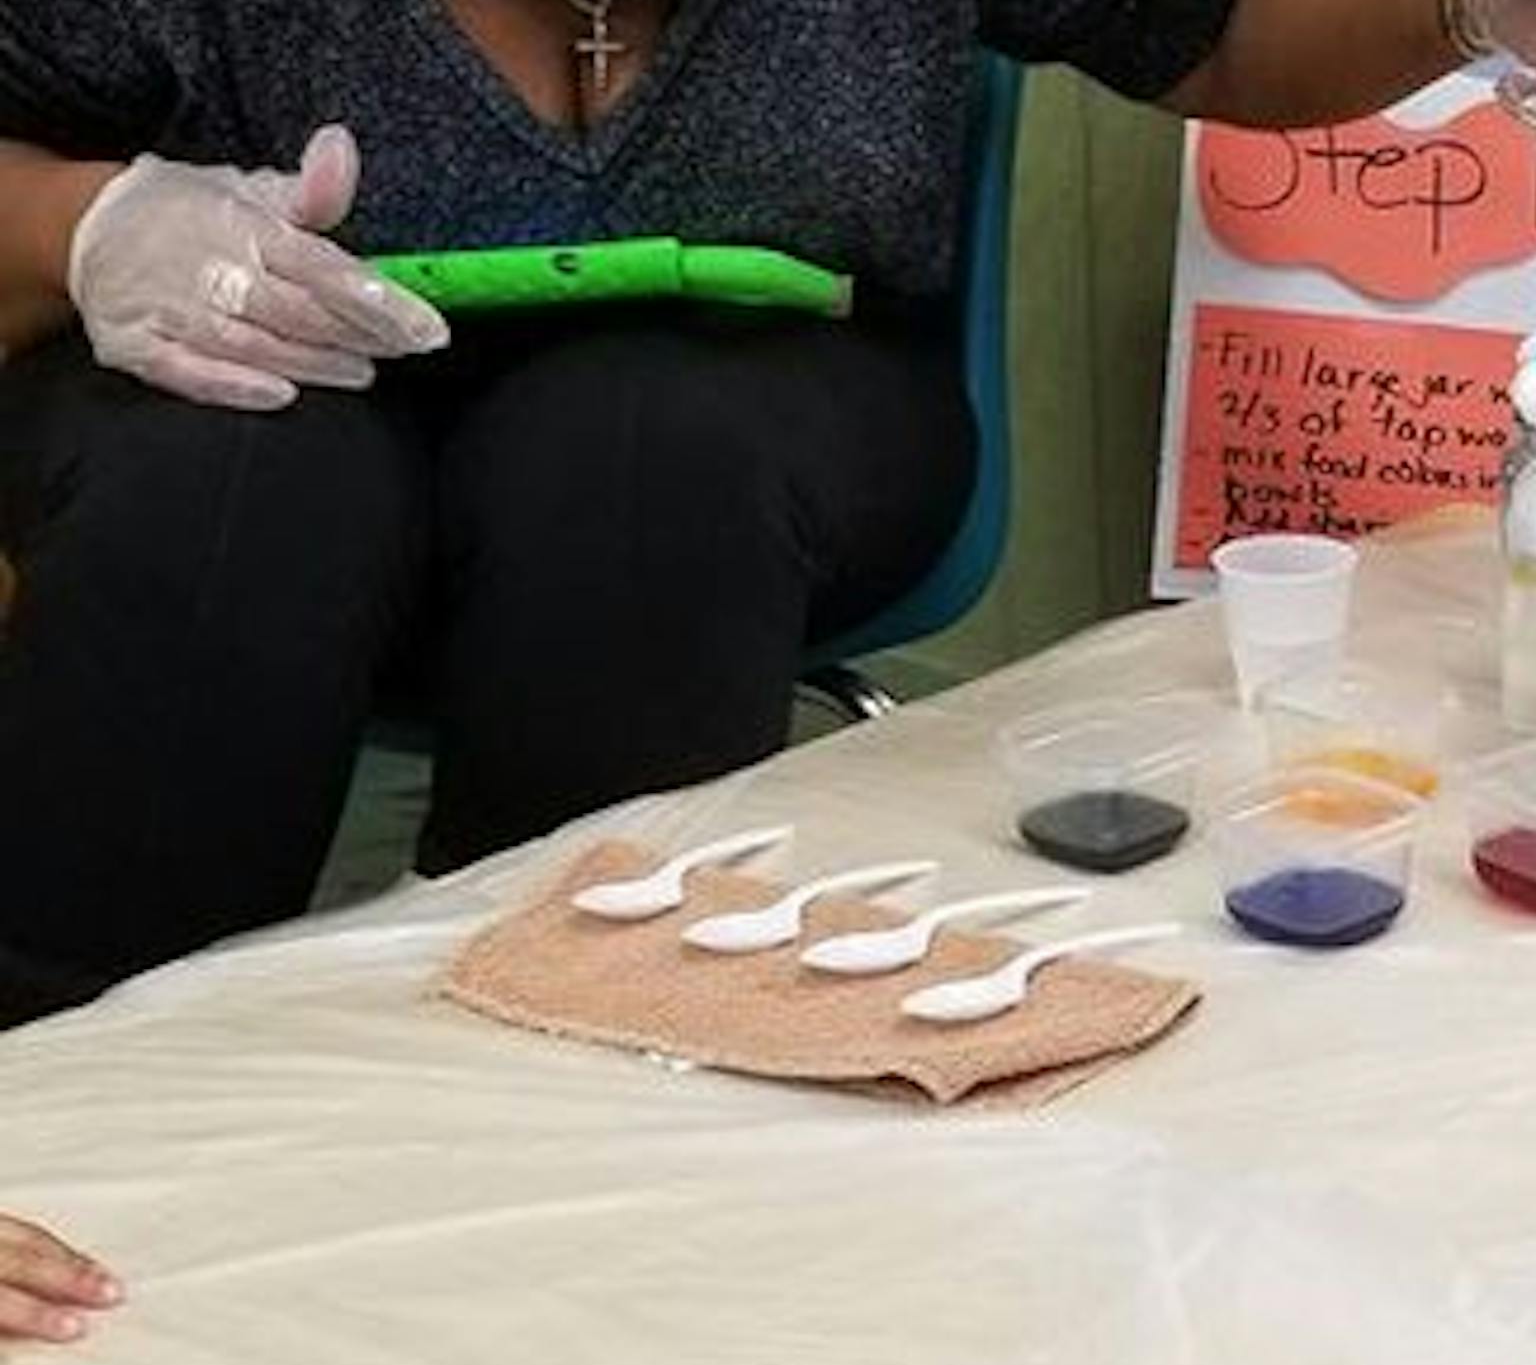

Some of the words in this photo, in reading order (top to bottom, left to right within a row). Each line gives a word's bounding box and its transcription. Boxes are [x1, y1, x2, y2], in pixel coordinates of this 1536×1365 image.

[1210, 127, 1488, 254] Step
[1299, 399, 1345, 435] of
[1372, 405, 1447, 453] tap
